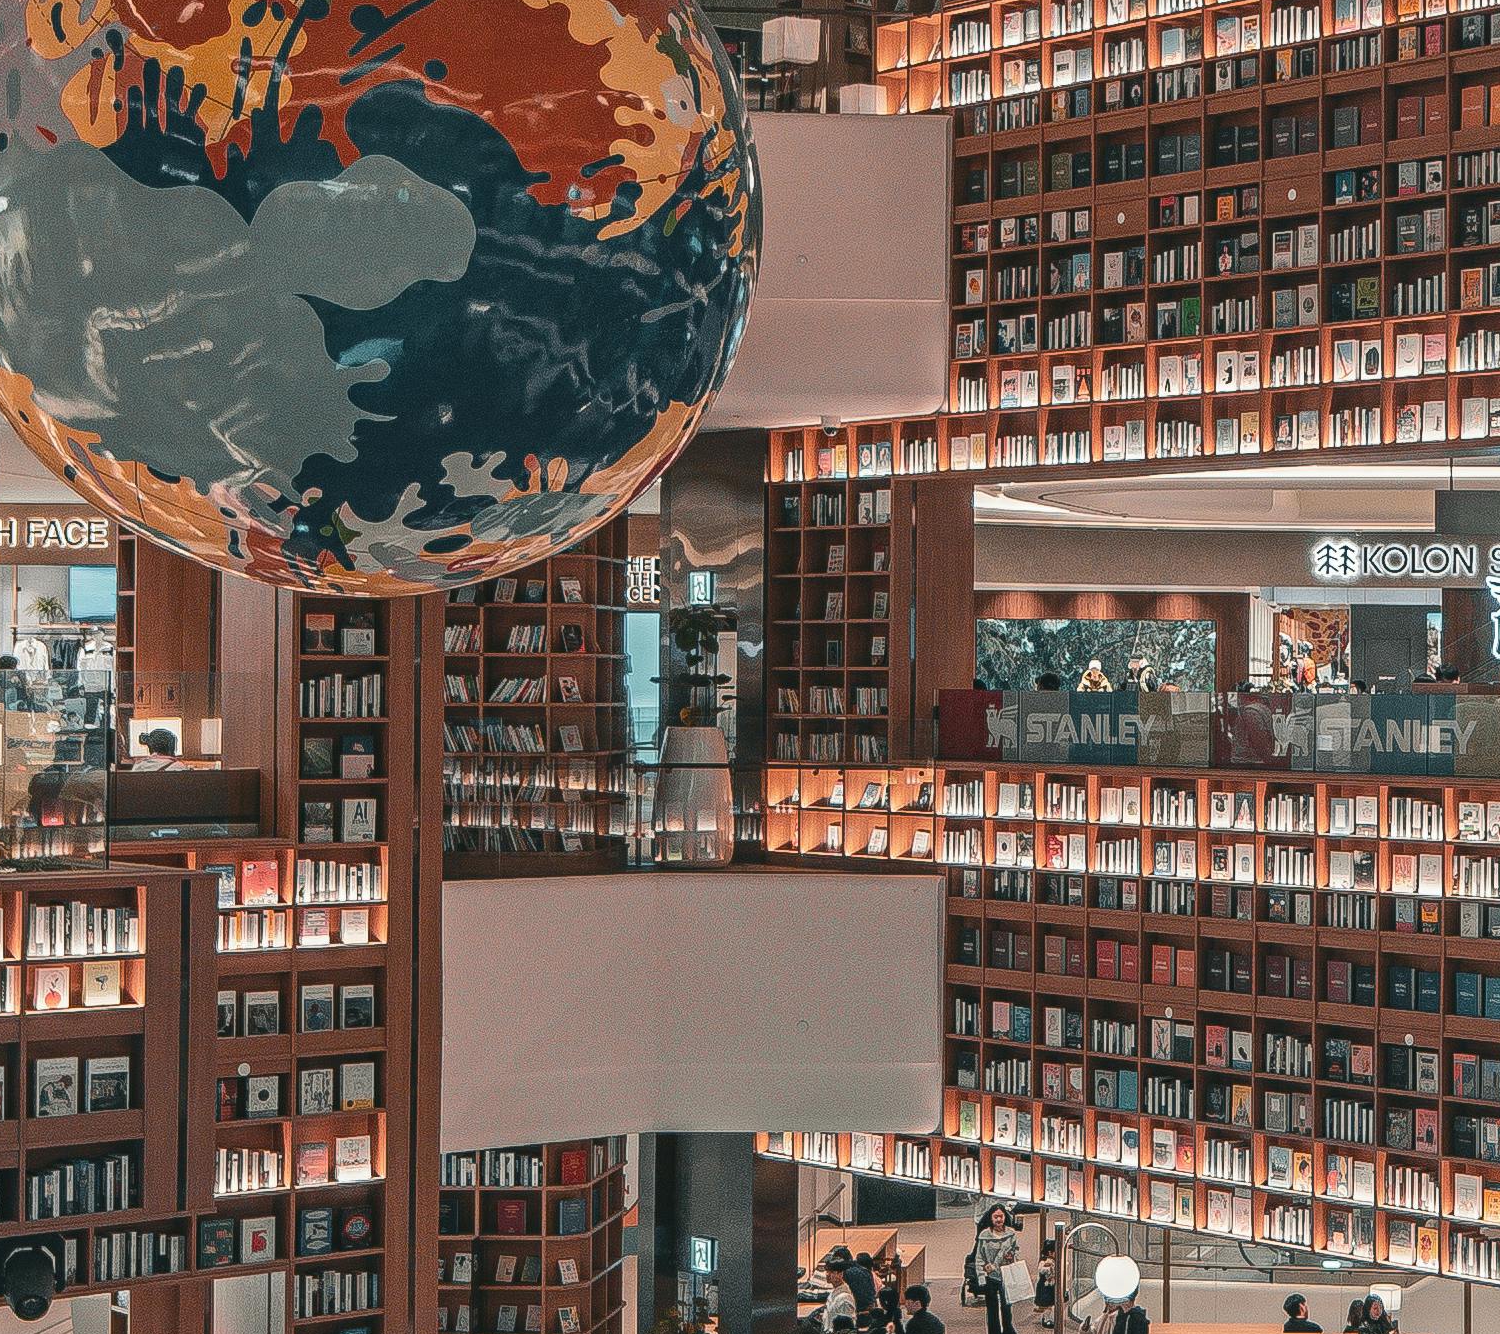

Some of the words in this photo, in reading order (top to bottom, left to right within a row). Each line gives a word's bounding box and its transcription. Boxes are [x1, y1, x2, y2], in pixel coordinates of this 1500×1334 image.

[28, 518, 109, 549] FACE
[1363, 545, 1474, 575] KOLON
[1026, 713, 1160, 747] STANLEY
[1318, 717, 1477, 755] STANLEY
